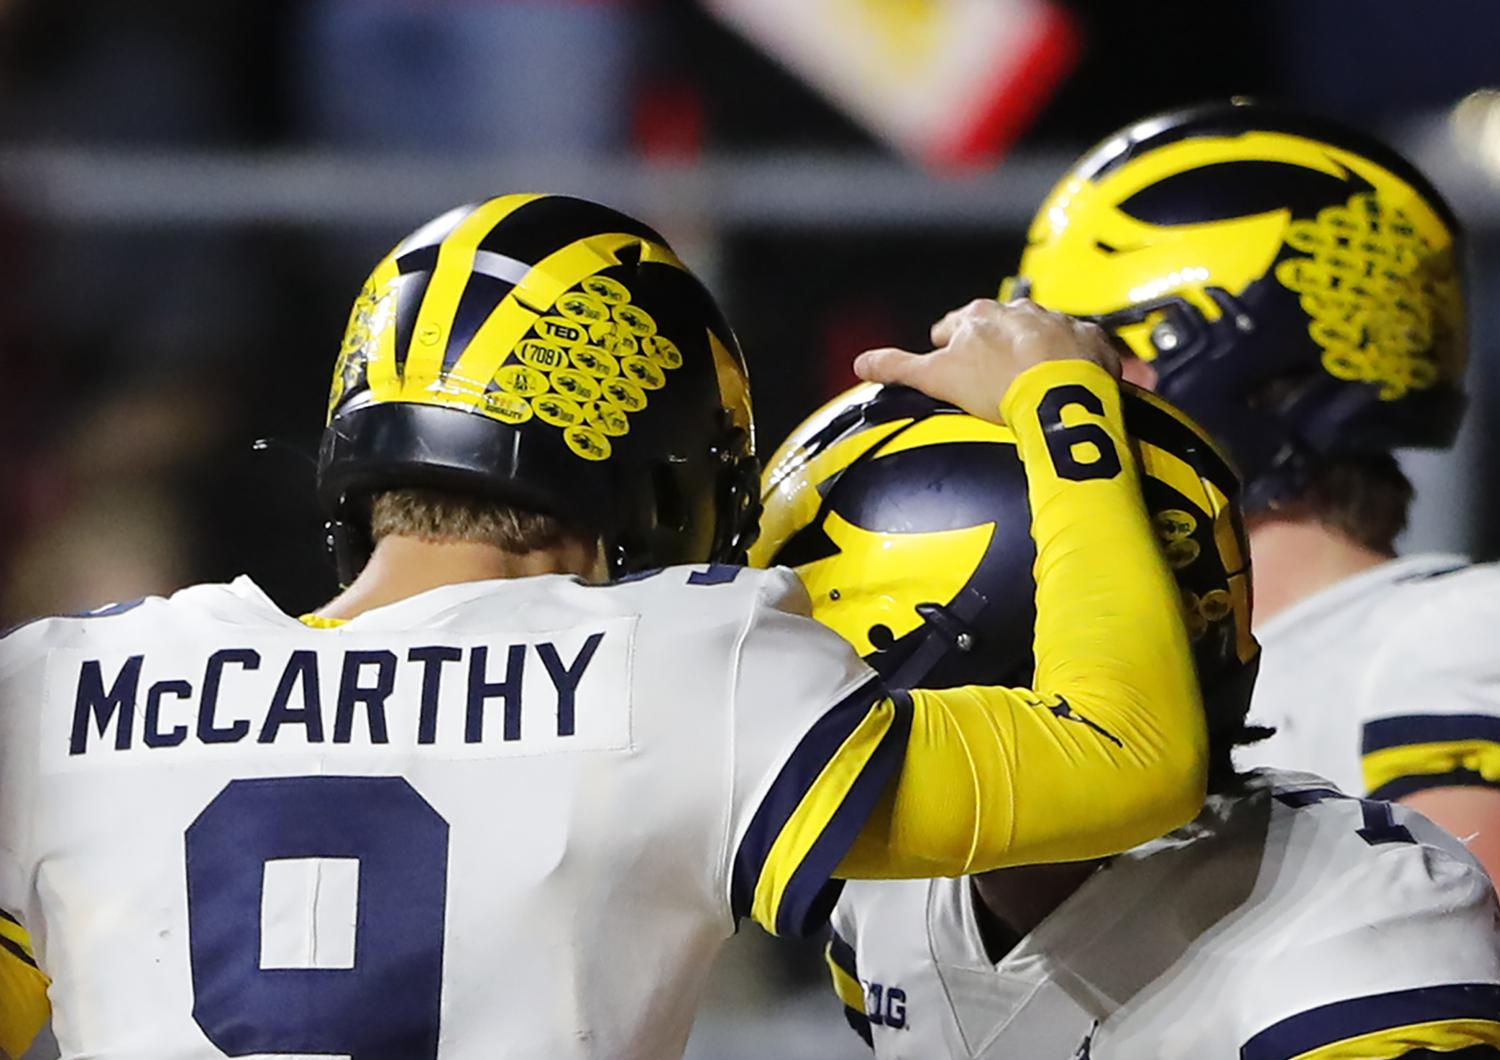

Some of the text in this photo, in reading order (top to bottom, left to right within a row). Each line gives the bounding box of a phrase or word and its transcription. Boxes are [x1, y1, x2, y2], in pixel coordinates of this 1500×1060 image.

[521, 342, 562, 367] (708)
[544, 320, 580, 341] TED
[1036, 384, 1122, 481] 6
[69, 632, 606, 756] McCARTHY
